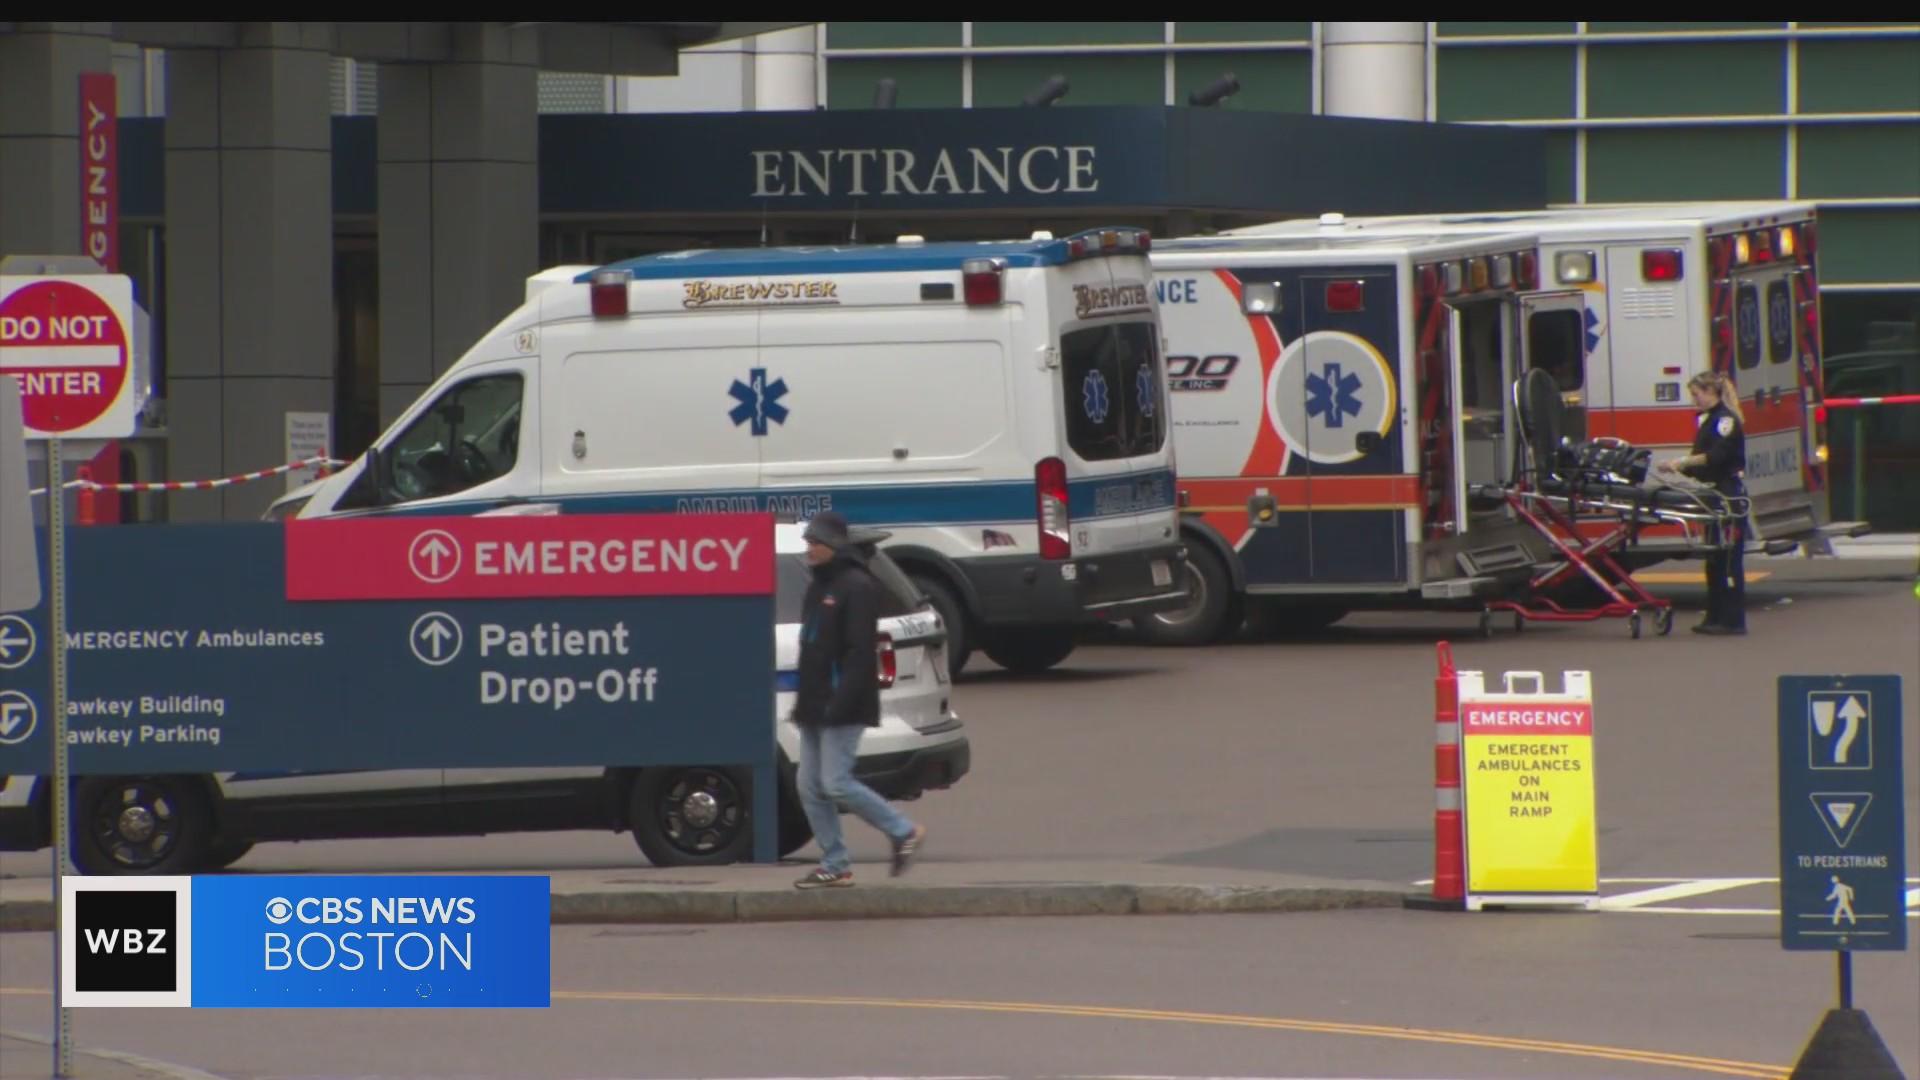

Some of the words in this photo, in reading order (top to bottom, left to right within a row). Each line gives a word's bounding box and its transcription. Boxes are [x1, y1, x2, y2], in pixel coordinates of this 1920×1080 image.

[750, 146, 1099, 197] ENTRANCE
[88, 100, 107, 271] GENCY
[683, 280, 838, 306] BREWSTER
[0, 316, 41, 339] DO
[49, 315, 108, 339] NOT
[475, 538, 749, 576] EMERGENCY
[65, 631, 188, 650] MERGENCY
[196, 629, 325, 648] Ambulances
[480, 621, 630, 657] Patient
[480, 668, 659, 710] Drop-Off
[67, 698, 132, 717] awkey
[140, 695, 225, 716] Building
[1470, 711, 1585, 727] EMERGENCY
[67, 727, 132, 747] awkey
[140, 724, 221, 745] Parking
[1488, 744, 1569, 756] EMERGENT
[1477, 759, 1581, 771] AMBULANCES
[1519, 775, 1540, 787] ON
[1511, 791, 1549, 802] MAIN
[1510, 806, 1552, 818] RAMP
[1797, 855, 1812, 868] TO
[1814, 855, 1888, 868] PEDESTRIANS
